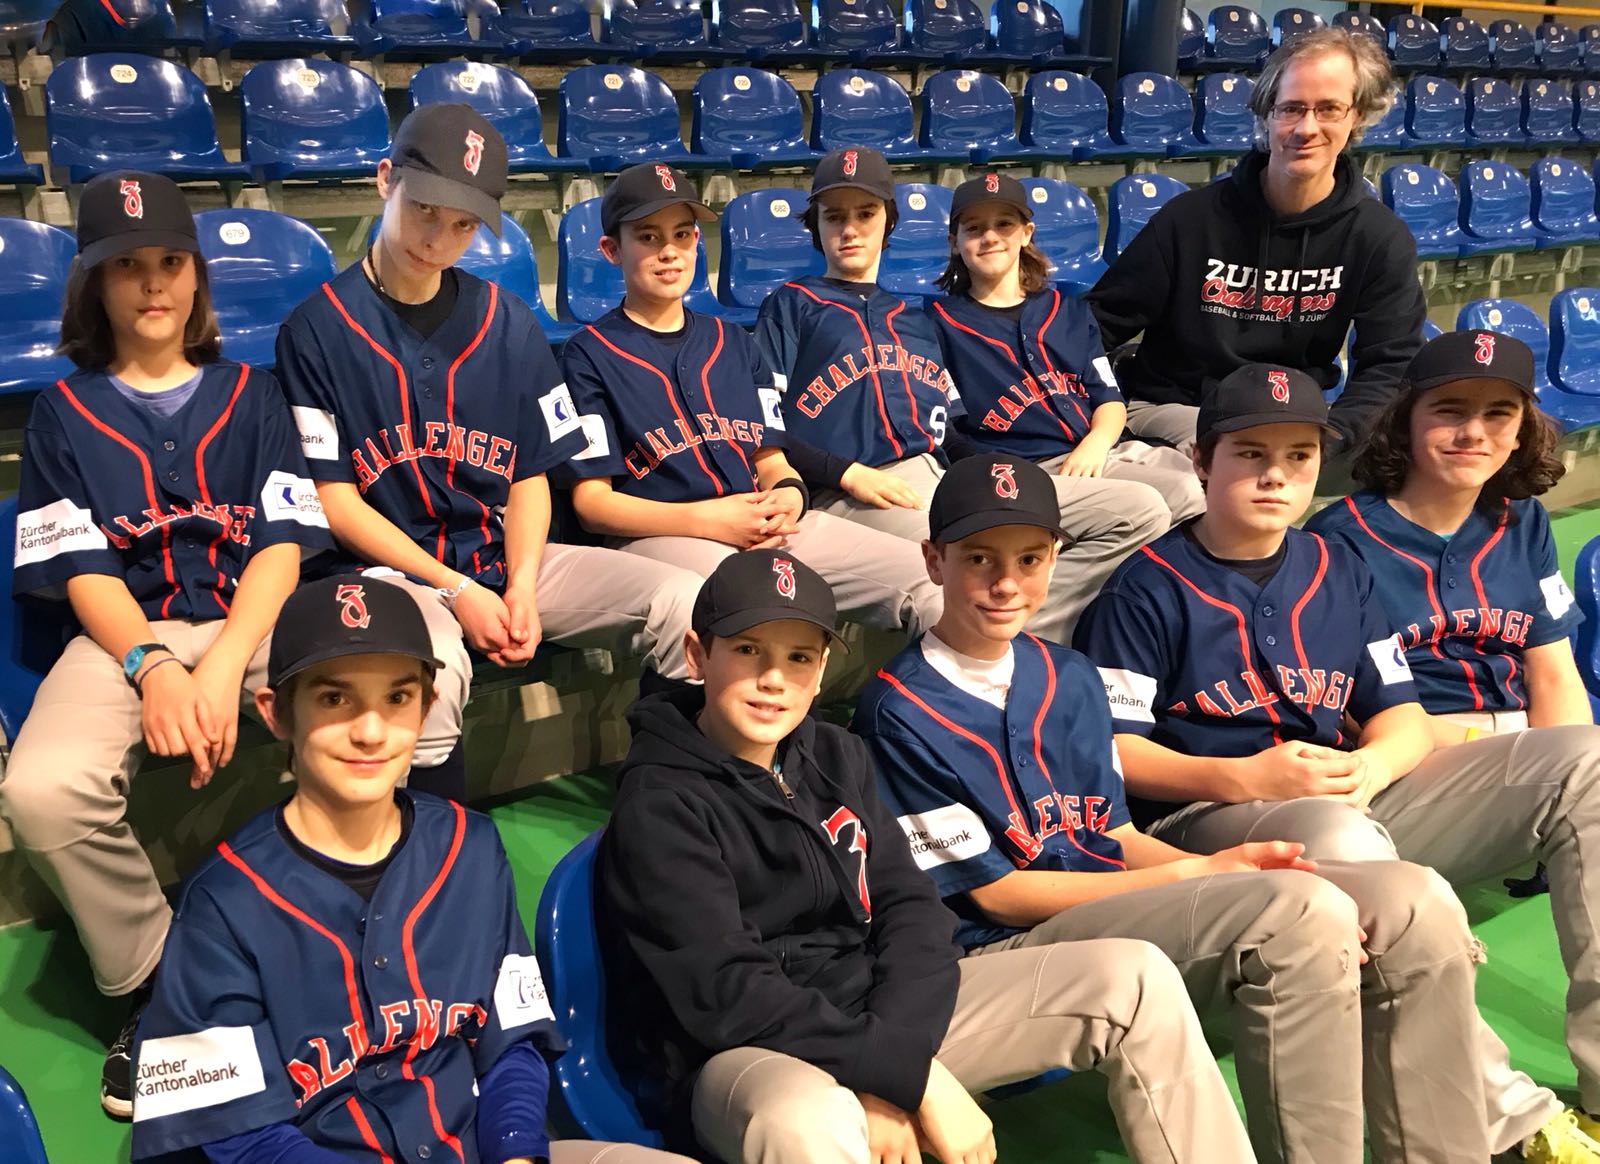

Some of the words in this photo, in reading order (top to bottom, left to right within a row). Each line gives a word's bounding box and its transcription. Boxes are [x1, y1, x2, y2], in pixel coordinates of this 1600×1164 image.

[1204, 257, 1345, 293] ZURICH
[1200, 276, 1337, 320] Challngers
[20, 520, 57, 539] Zürcher
[20, 524, 91, 551] Kantonalbank
[134, 1061, 240, 1099] Kantonalbank
